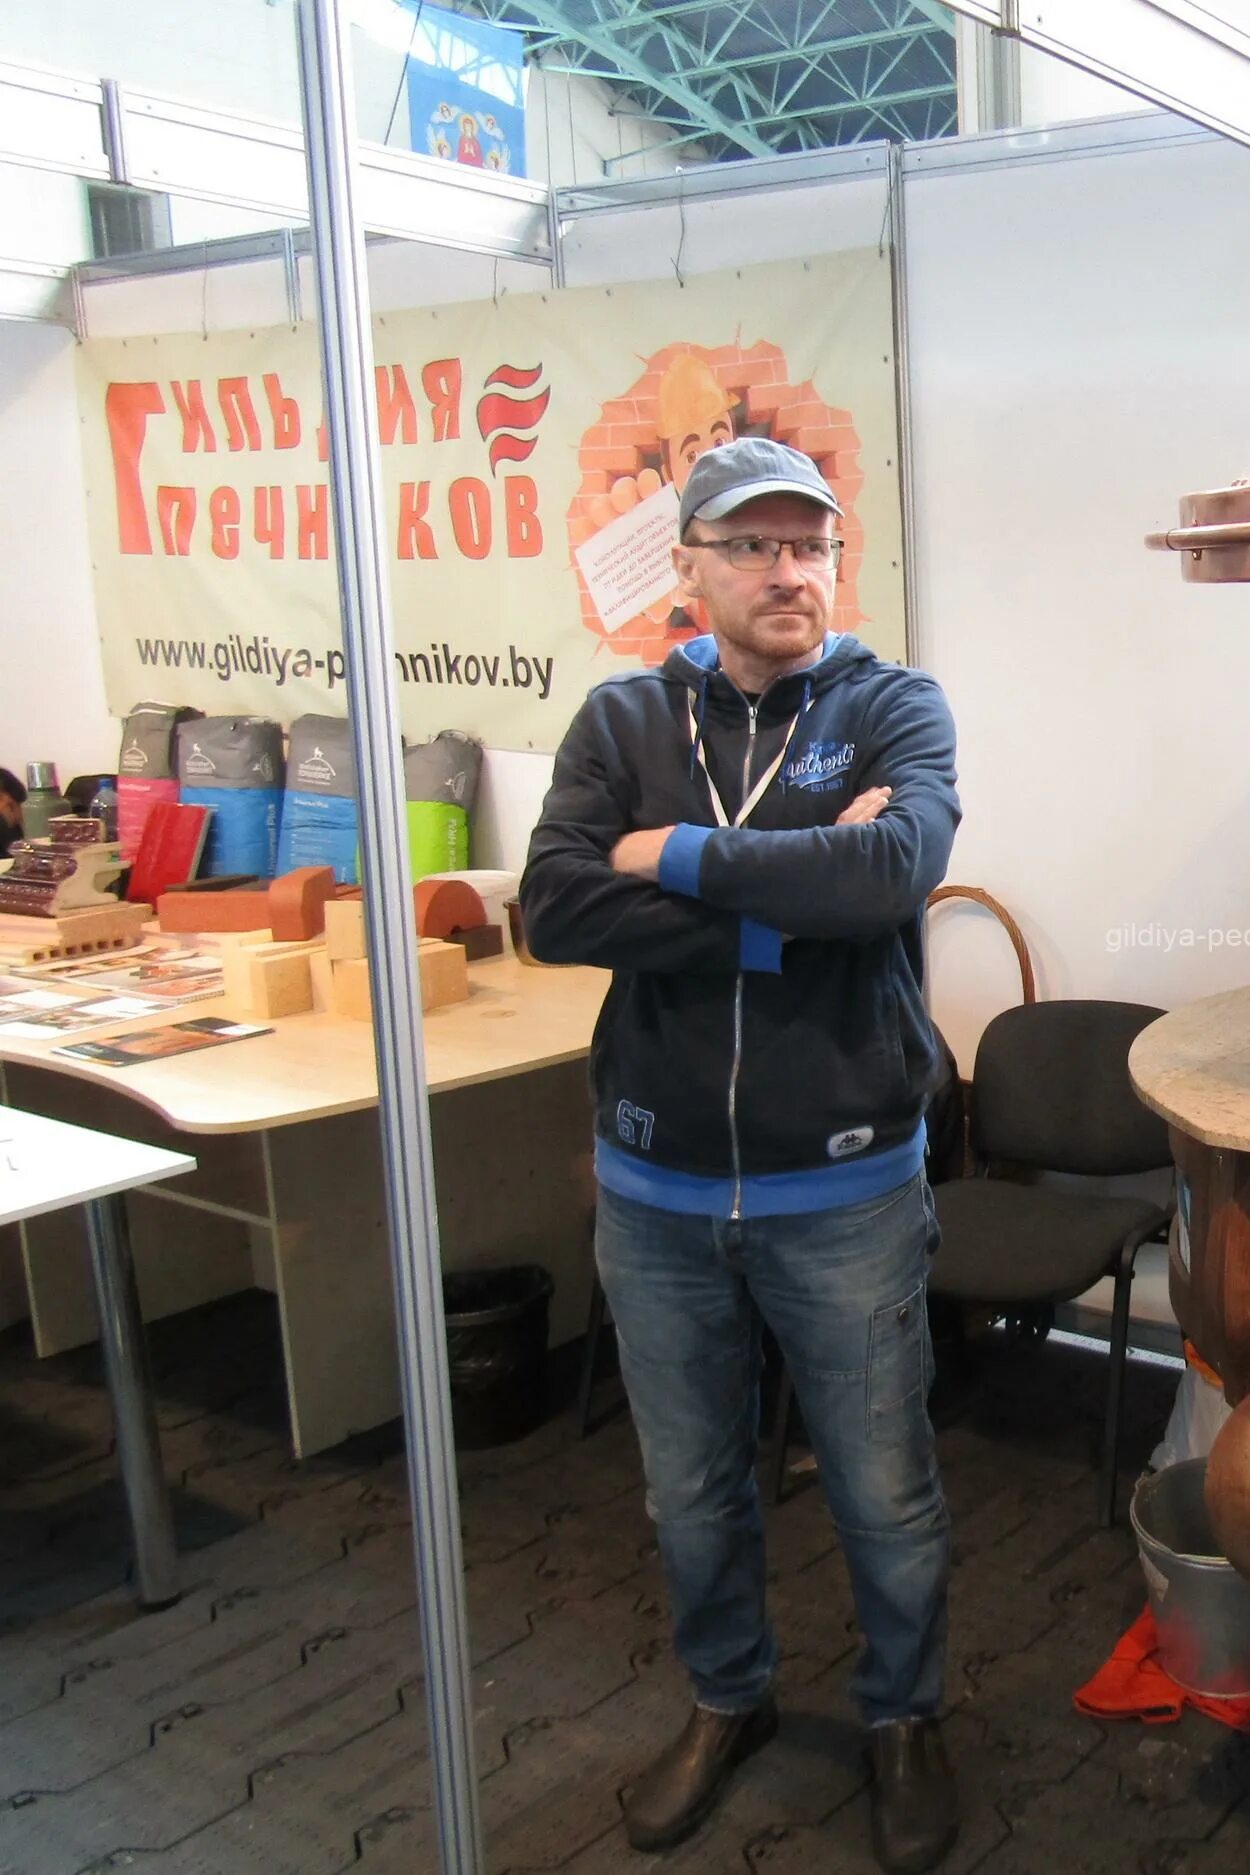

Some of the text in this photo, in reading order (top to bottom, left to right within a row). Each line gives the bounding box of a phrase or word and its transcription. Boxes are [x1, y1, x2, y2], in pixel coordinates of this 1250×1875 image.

[105, 358, 462, 555] Гильия
[156, 475, 544, 560] печнков
[136, 634, 554, 700] www.gildiya-pnikov.by
[617, 1099, 655, 1150] 67
